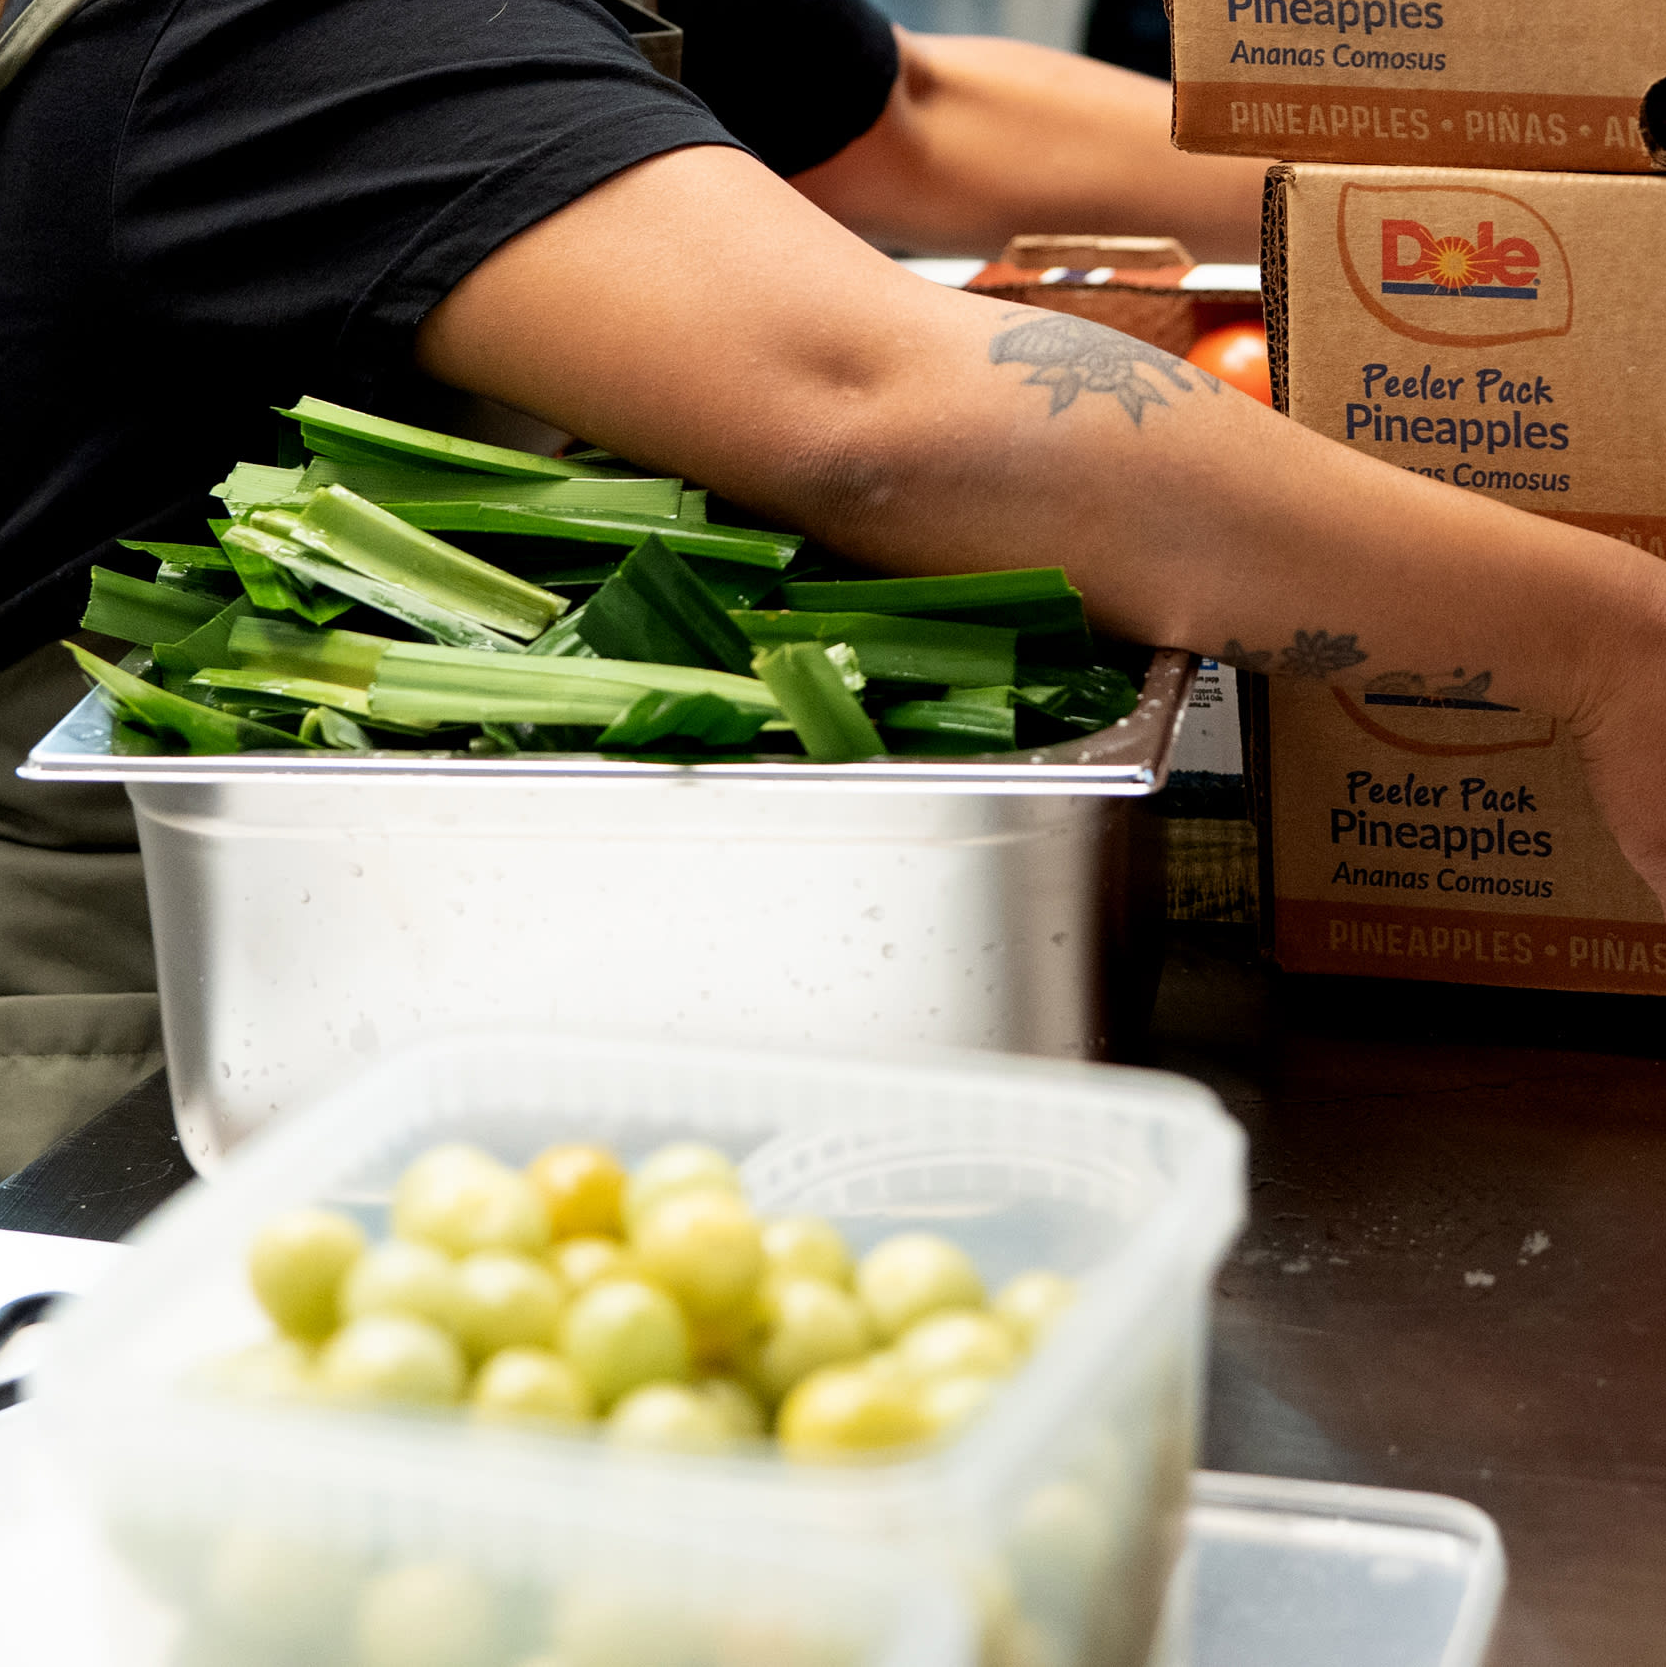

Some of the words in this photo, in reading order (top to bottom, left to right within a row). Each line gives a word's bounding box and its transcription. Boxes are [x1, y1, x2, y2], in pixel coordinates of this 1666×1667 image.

[1229, 39, 1325, 68] Ananas
[1332, 43, 1446, 72] Comosus
[1231, 100, 1430, 140] PINEAPPLES
[1464, 104, 1568, 146] PIÑAS
[1381, 219, 1541, 290] Dole
[1361, 363, 1465, 401] Peeler
[1475, 368, 1554, 406] Pack
[1346, 402, 1569, 455] Pineapples
[1452, 462, 1571, 493] Comosus
[1346, 770, 1449, 808] Peeler
[1459, 777, 1537, 814] Pack
[1330, 807, 1553, 861] Pineapples
[1330, 860, 1429, 890] Ananas
[1436, 867, 1553, 899] Comosus
[1330, 919, 1533, 965] PINEAPPLES
